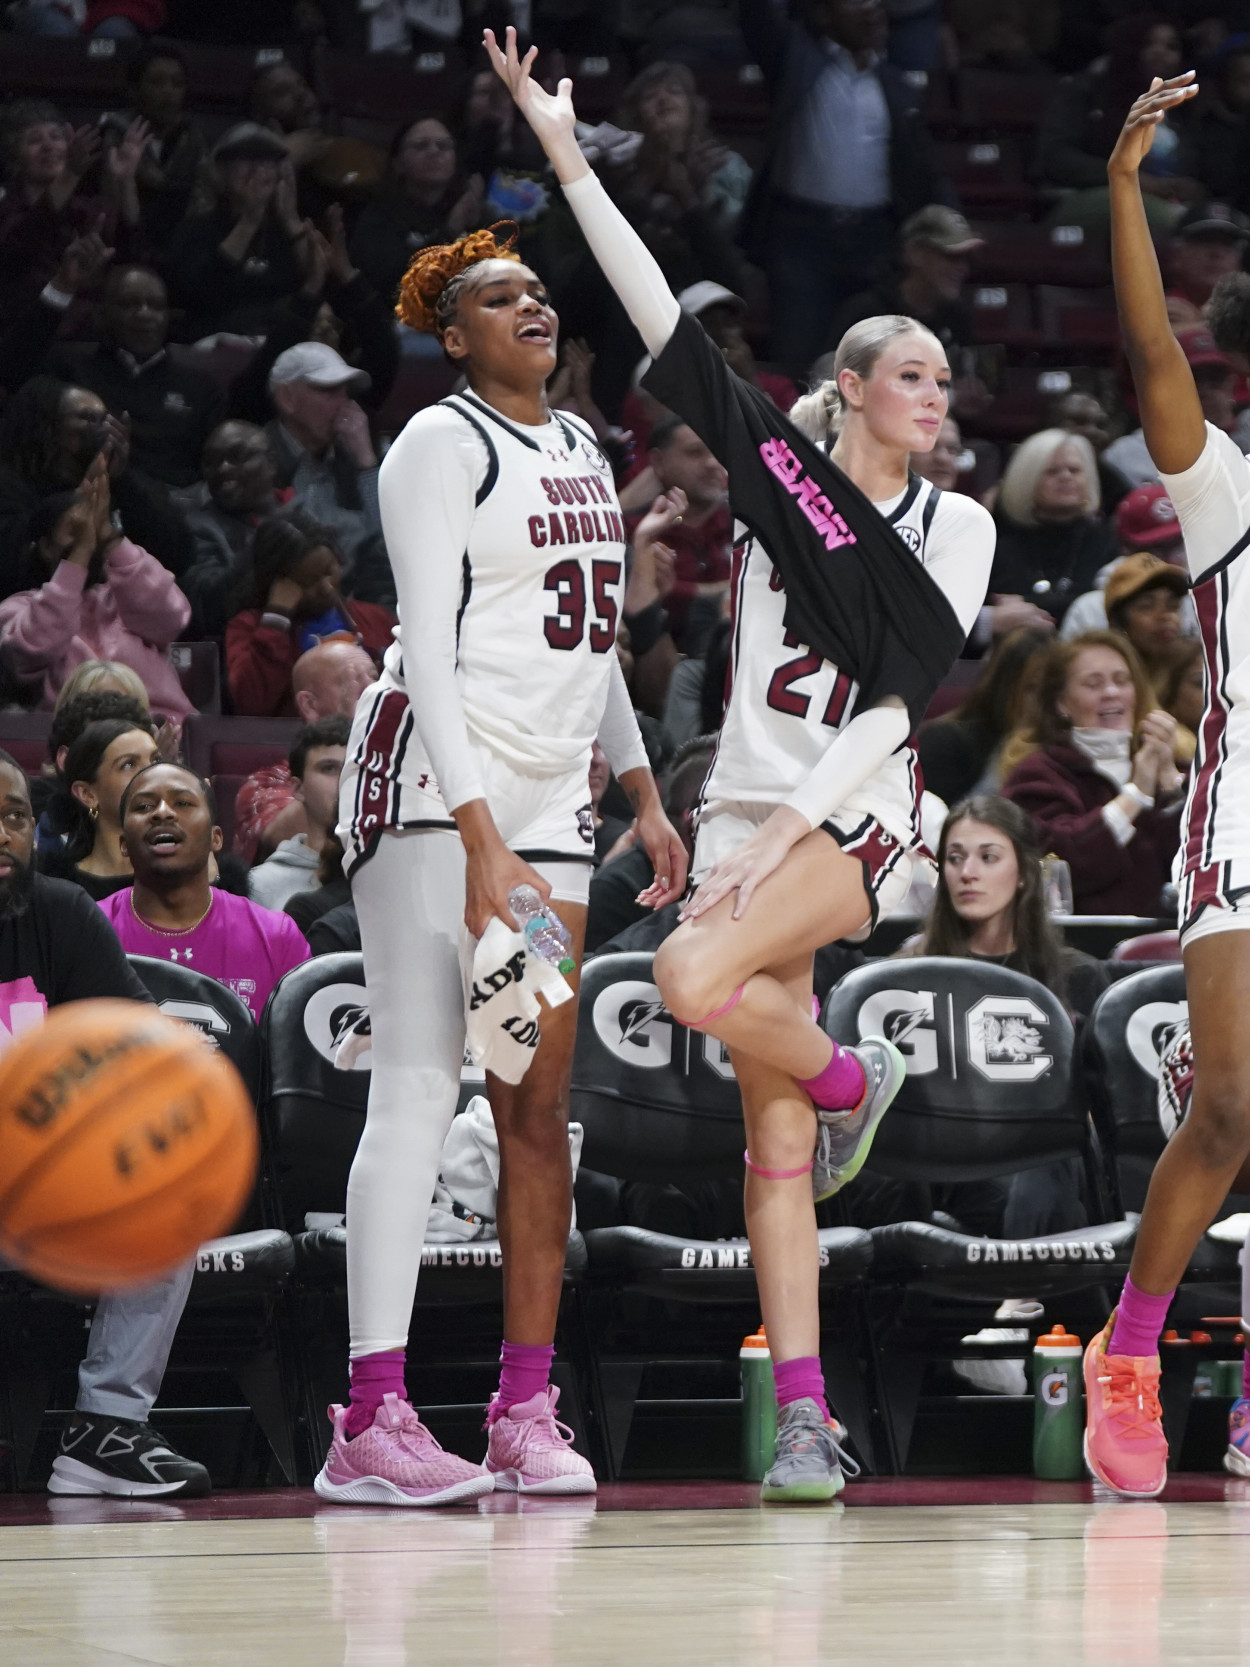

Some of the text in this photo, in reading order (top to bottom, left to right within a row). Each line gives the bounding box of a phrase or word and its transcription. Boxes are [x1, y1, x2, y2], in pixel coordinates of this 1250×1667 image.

[540, 475, 612, 506] SOUTH
[528, 513, 626, 548] CAROLIN
[895, 527, 920, 552] EC
[543, 559, 622, 654] 35
[766, 630, 856, 729] 21
[858, 989, 939, 1075] G
[197, 1251, 245, 1272] CKS
[967, 1241, 1116, 1263] GAMECOCKS
[1042, 1372, 1068, 1406] G
